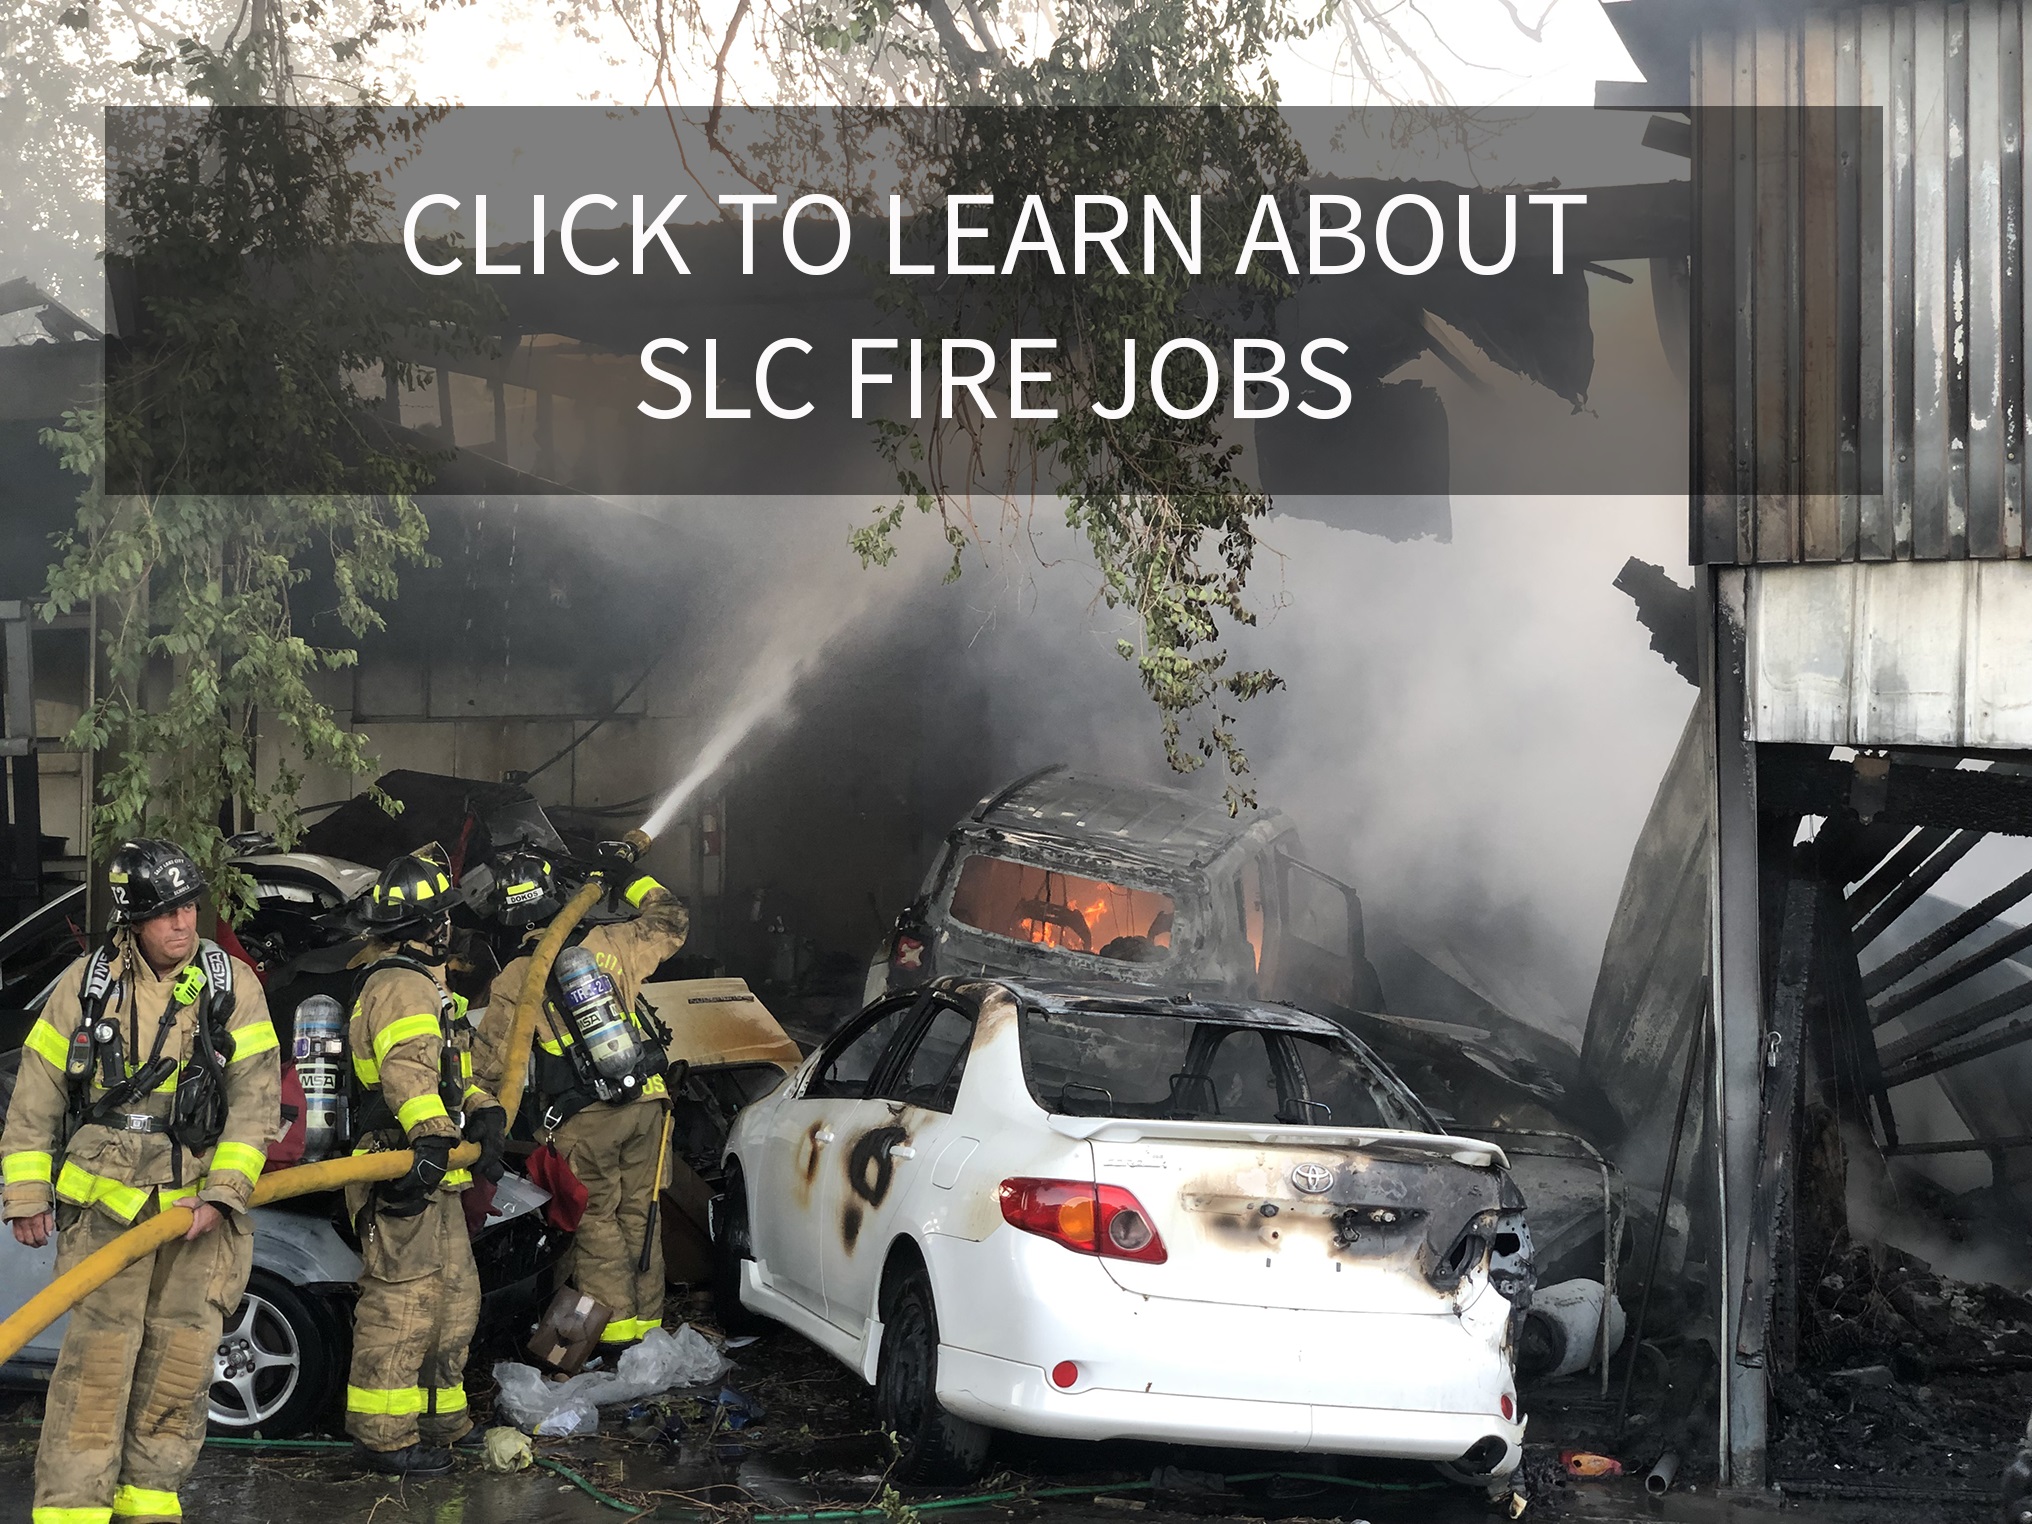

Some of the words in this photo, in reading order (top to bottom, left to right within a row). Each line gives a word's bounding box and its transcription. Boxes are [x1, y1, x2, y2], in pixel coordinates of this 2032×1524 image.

[154, 865, 163, 876] SALT
[163, 859, 174, 868] LAKE
[168, 867, 185, 887] 2
[510, 890, 539, 903] DOKOS
[95, 952, 108, 978] MS
[208, 952, 226, 990] MSA
[301, 1075, 335, 1087] MSA
